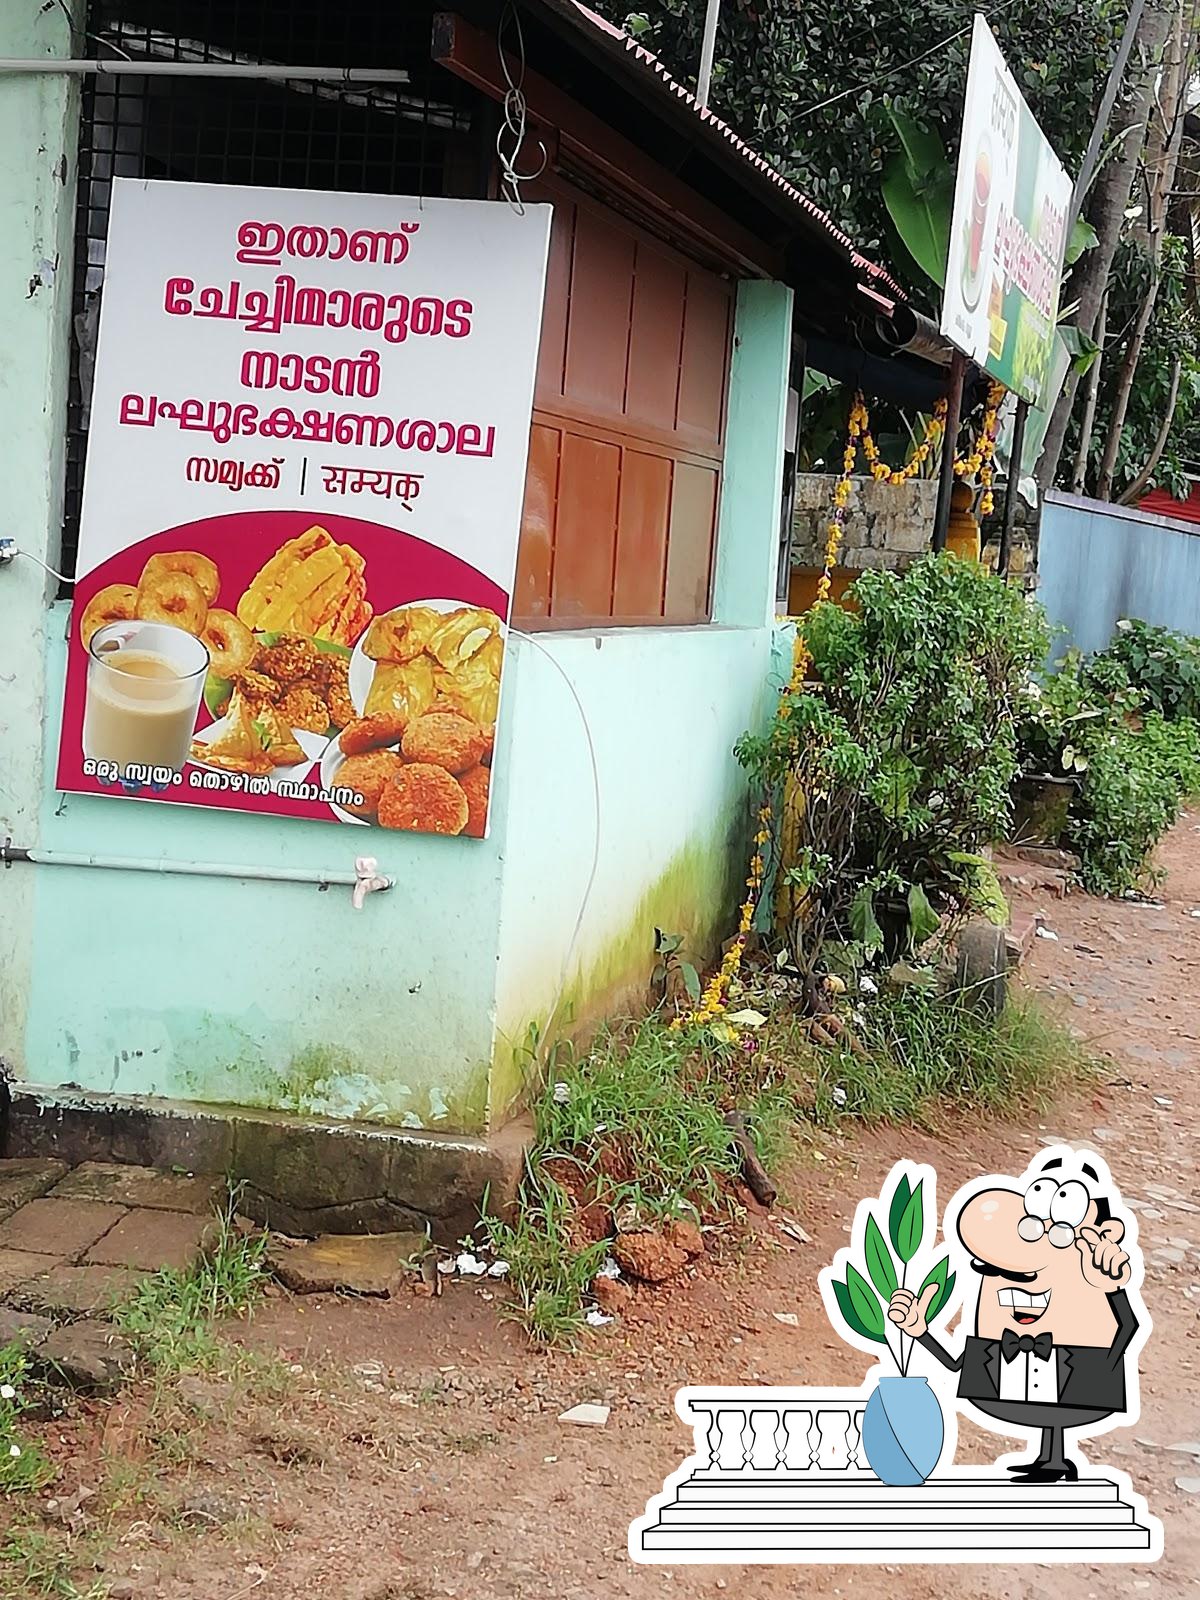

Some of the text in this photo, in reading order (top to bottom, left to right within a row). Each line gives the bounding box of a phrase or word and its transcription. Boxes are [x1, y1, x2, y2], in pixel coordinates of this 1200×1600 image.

[236, 220, 419, 265] ഇതാണ്
[240, 350, 381, 398] നാടൻ
[119, 393, 496, 457] ലഘുഭക്ഷണശാല
[186, 456, 285, 491] സമ്യക്ക്
[320, 466, 424, 511] सम्यक्
[83, 758, 364, 807] ഒരു സ്വയം തൊഴിൽ സ്ഥാപനം
